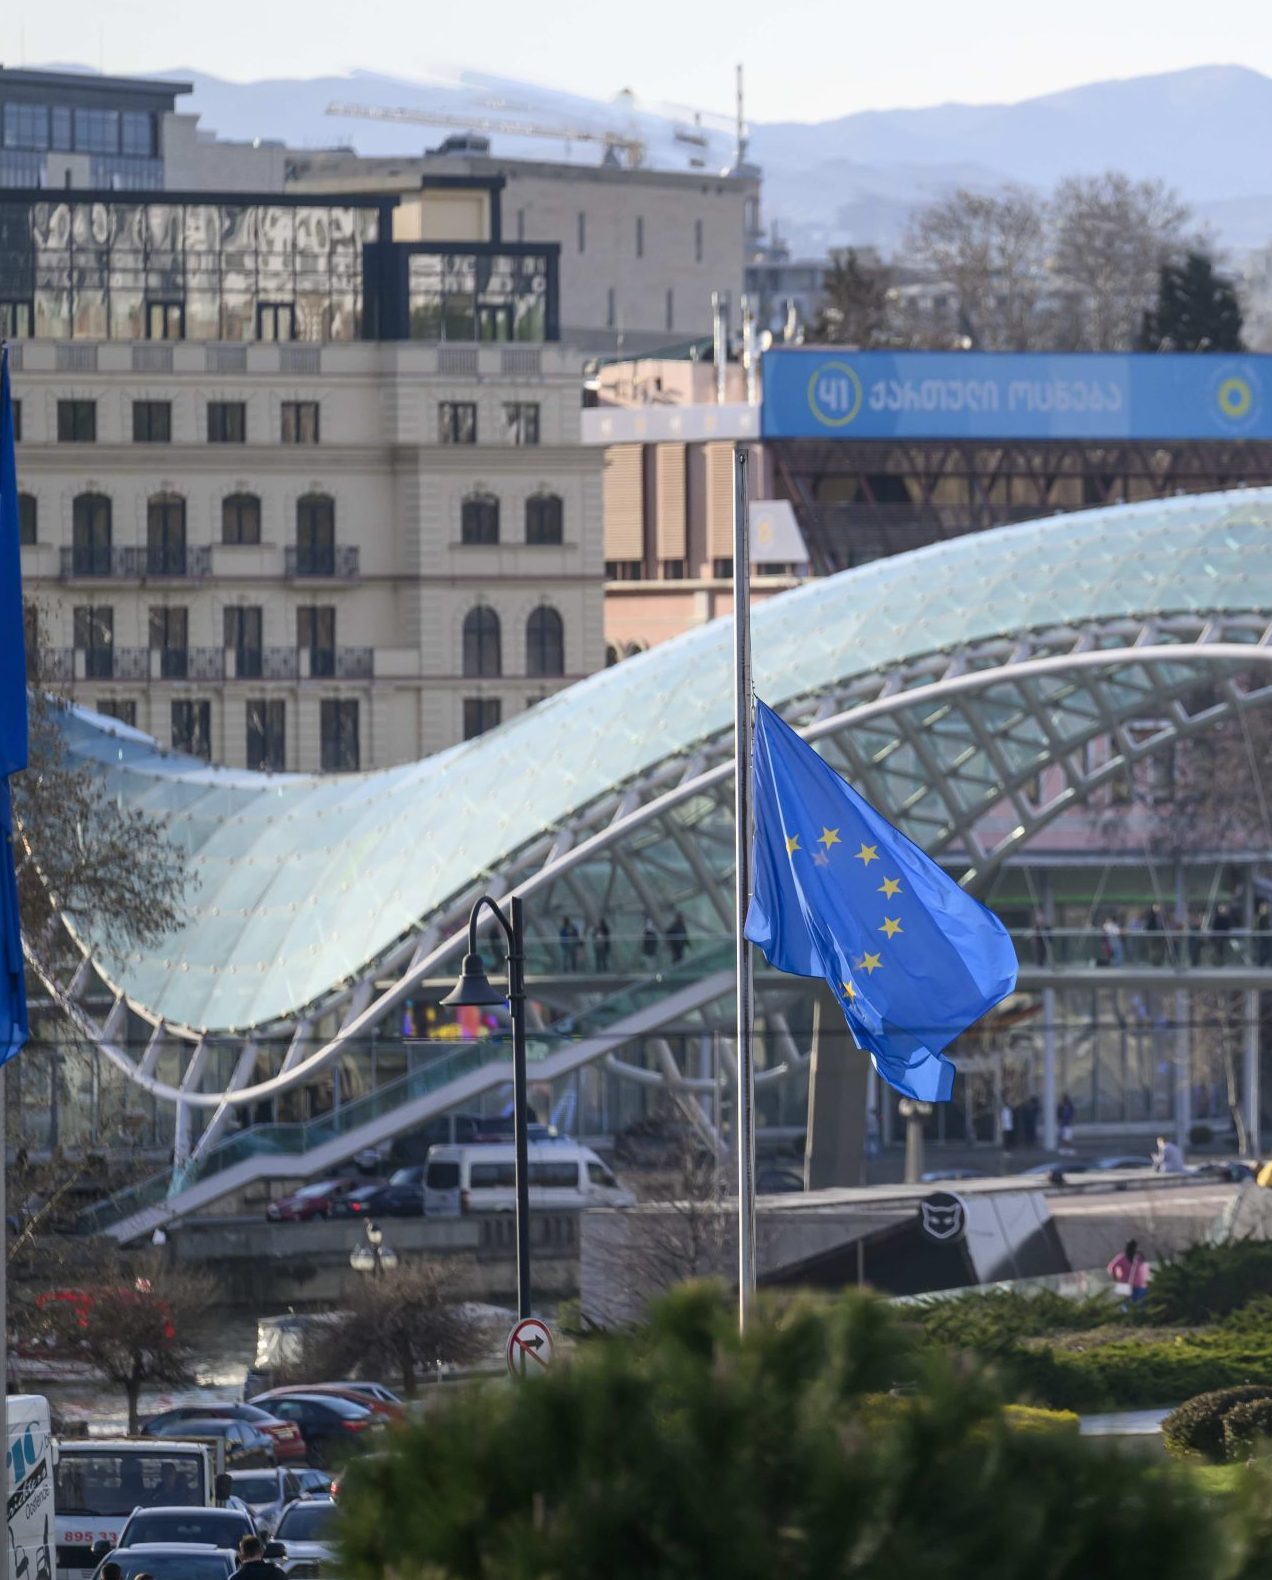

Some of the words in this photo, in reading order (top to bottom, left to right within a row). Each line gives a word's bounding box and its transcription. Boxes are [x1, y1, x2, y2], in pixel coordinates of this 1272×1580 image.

[819, 377, 849, 411] 41
[869, 379, 999, 412] ქართული
[1008, 379, 1123, 412] ოცნება
[64, 1531, 93, 1542] 895
